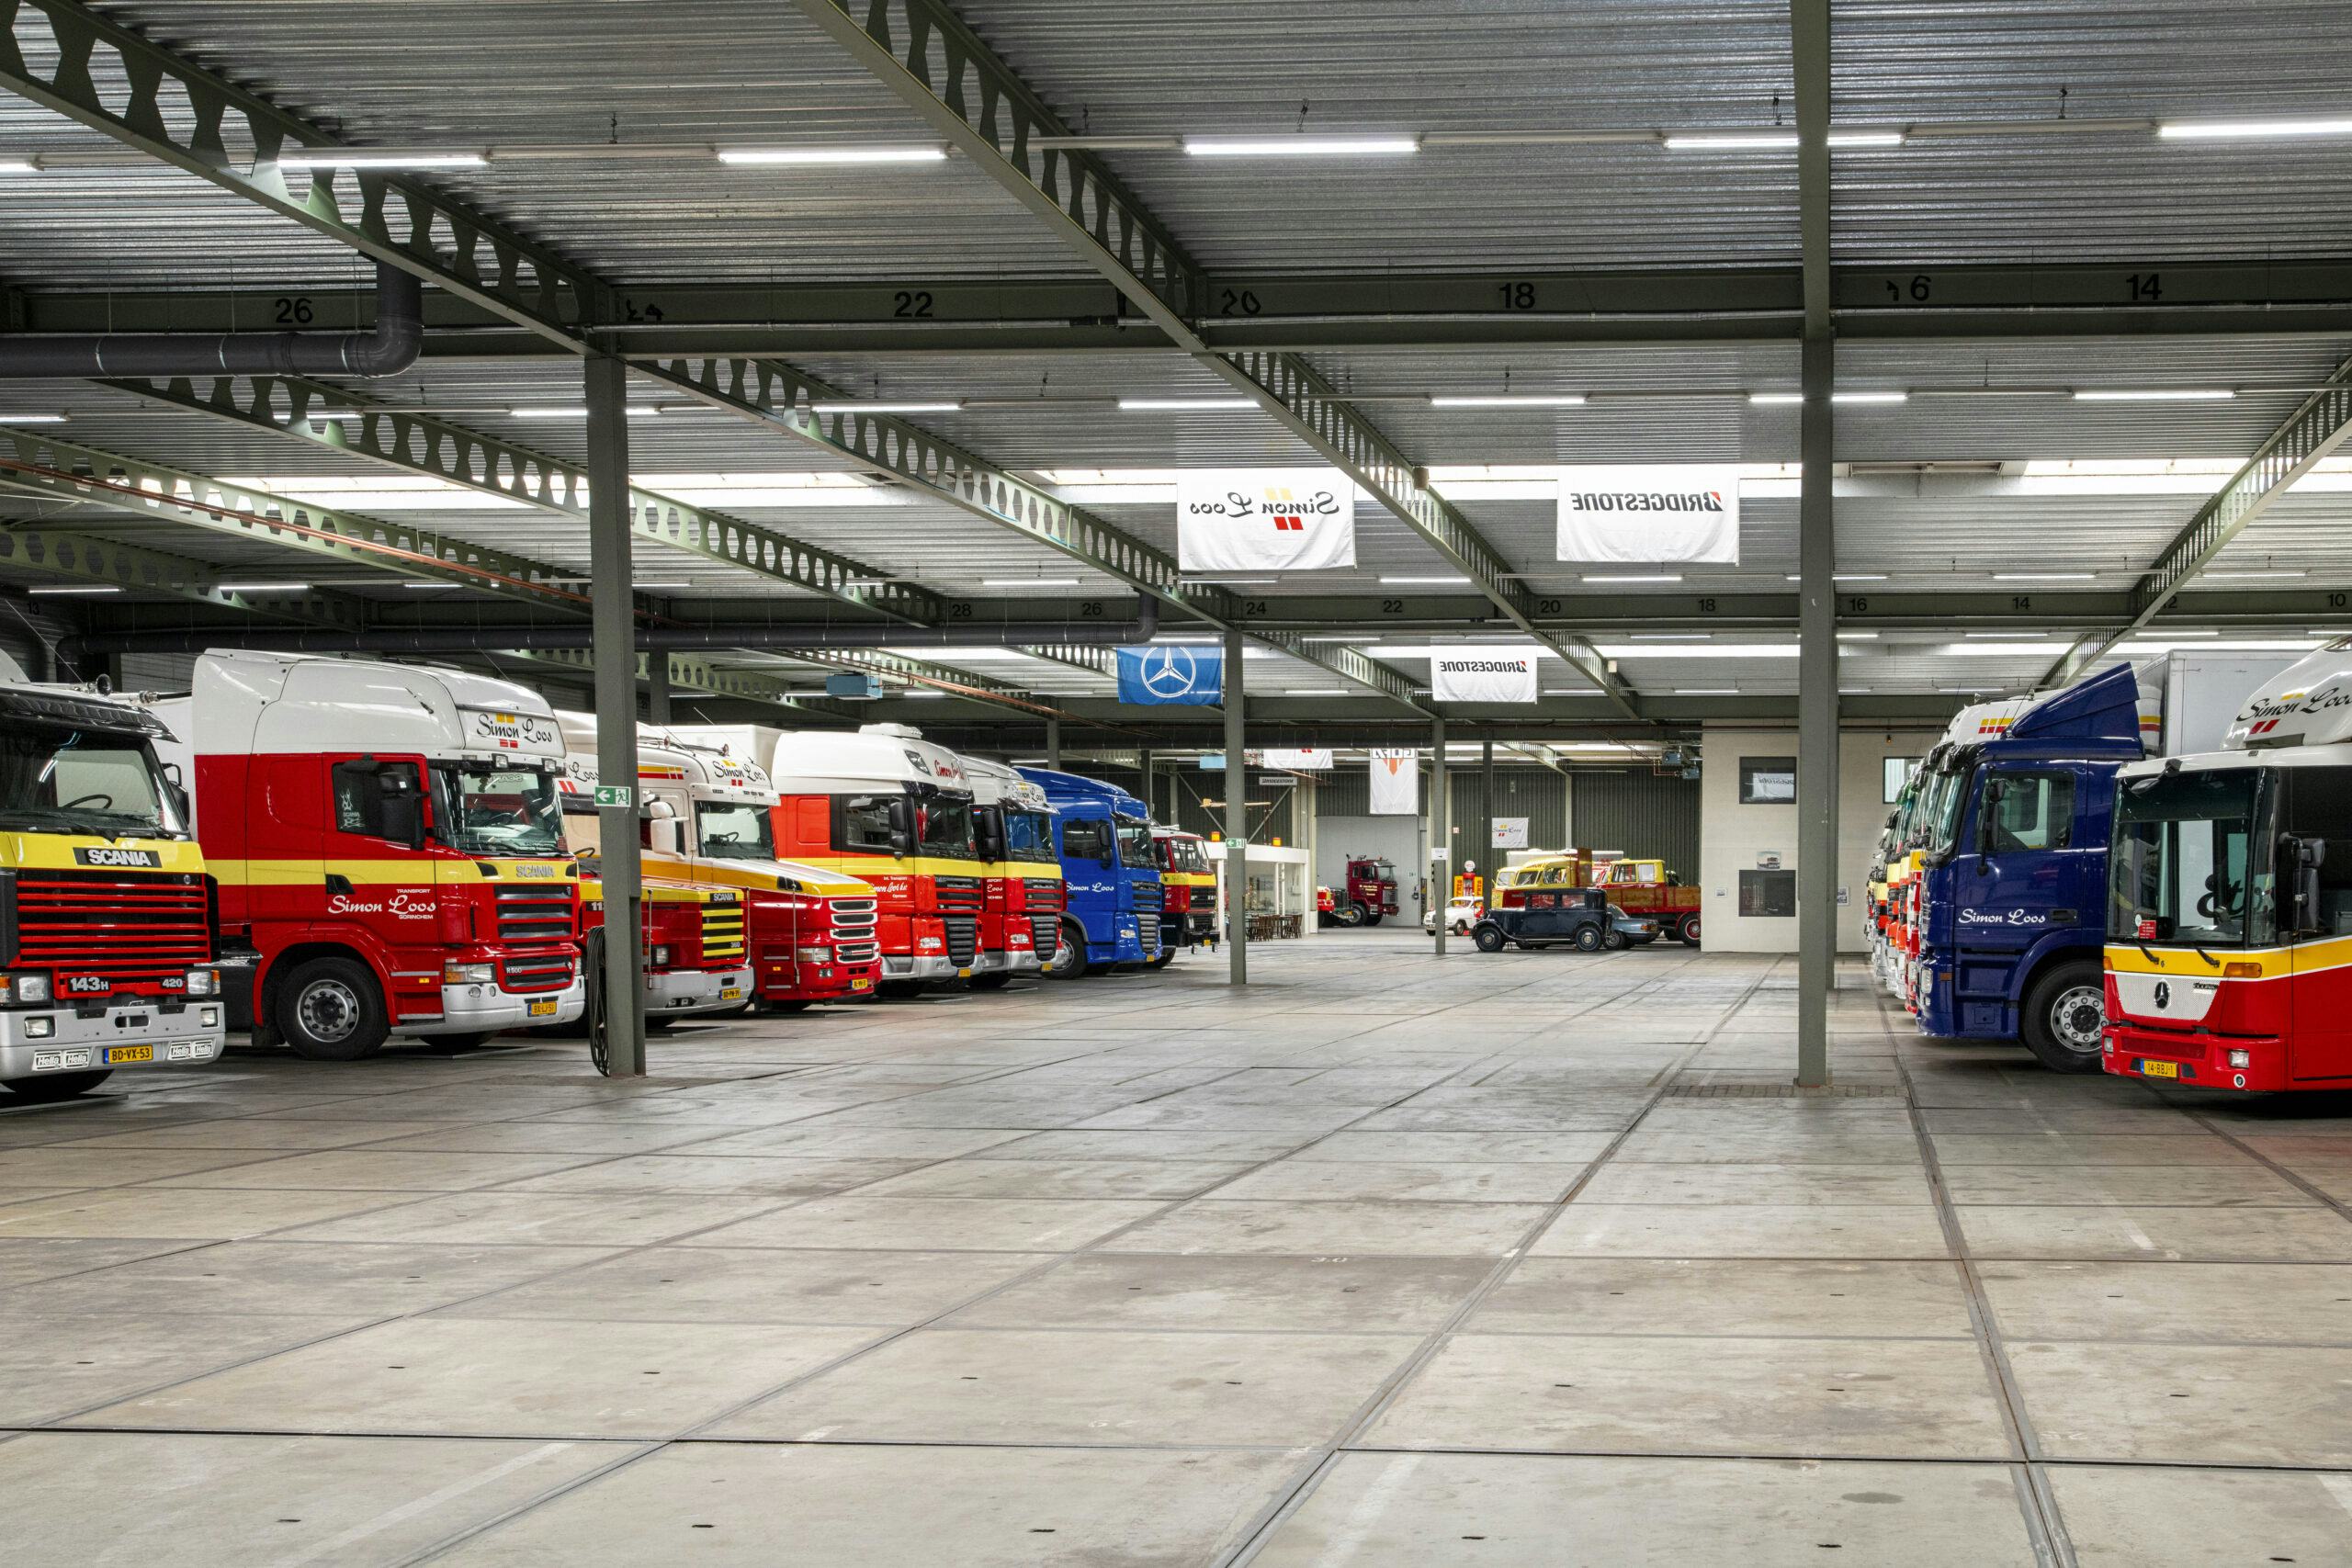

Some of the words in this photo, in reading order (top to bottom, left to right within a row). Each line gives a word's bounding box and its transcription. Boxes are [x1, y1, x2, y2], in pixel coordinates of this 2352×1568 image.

[2126, 274, 2162, 300] 14
[1222, 289, 1261, 315] 20
[1498, 283, 1534, 309] 18
[277, 298, 313, 323] 26
[894, 292, 933, 318] 22
[1699, 599, 1715, 611] 18
[1849, 598, 1867, 611] 16
[2012, 597, 2030, 609] 14
[2327, 593, 2346, 606] 10
[952, 604, 972, 616] 28
[1082, 602, 1102, 615] 26
[1246, 602, 1266, 615] 24
[1383, 600, 1403, 613] 22
[1541, 600, 1561, 614] 20
[2236, 698, 2301, 721] Simon
[477, 713, 519, 738] Simon
[522, 718, 552, 743] Loos
[712, 761, 744, 778] Simon
[87, 850, 152, 866] SCANIA
[515, 864, 555, 878] SCANIA
[1091, 882, 1114, 893] Loos
[713, 893, 734, 901] SCANIA
[328, 895, 382, 914] Simon
[389, 895, 436, 915] Loos
[592, 902, 604, 911] 11
[1959, 908, 2003, 923] Simon
[2007, 908, 2046, 925] Loos
[163, 978, 183, 988] 420
[111, 1047, 151, 1061] BD-VX-53
[172, 1045, 190, 1056] Hella
[195, 1043, 212, 1055] Hella
[36, 1055, 60, 1066] Hella
[67, 1052, 87, 1064] Hella
